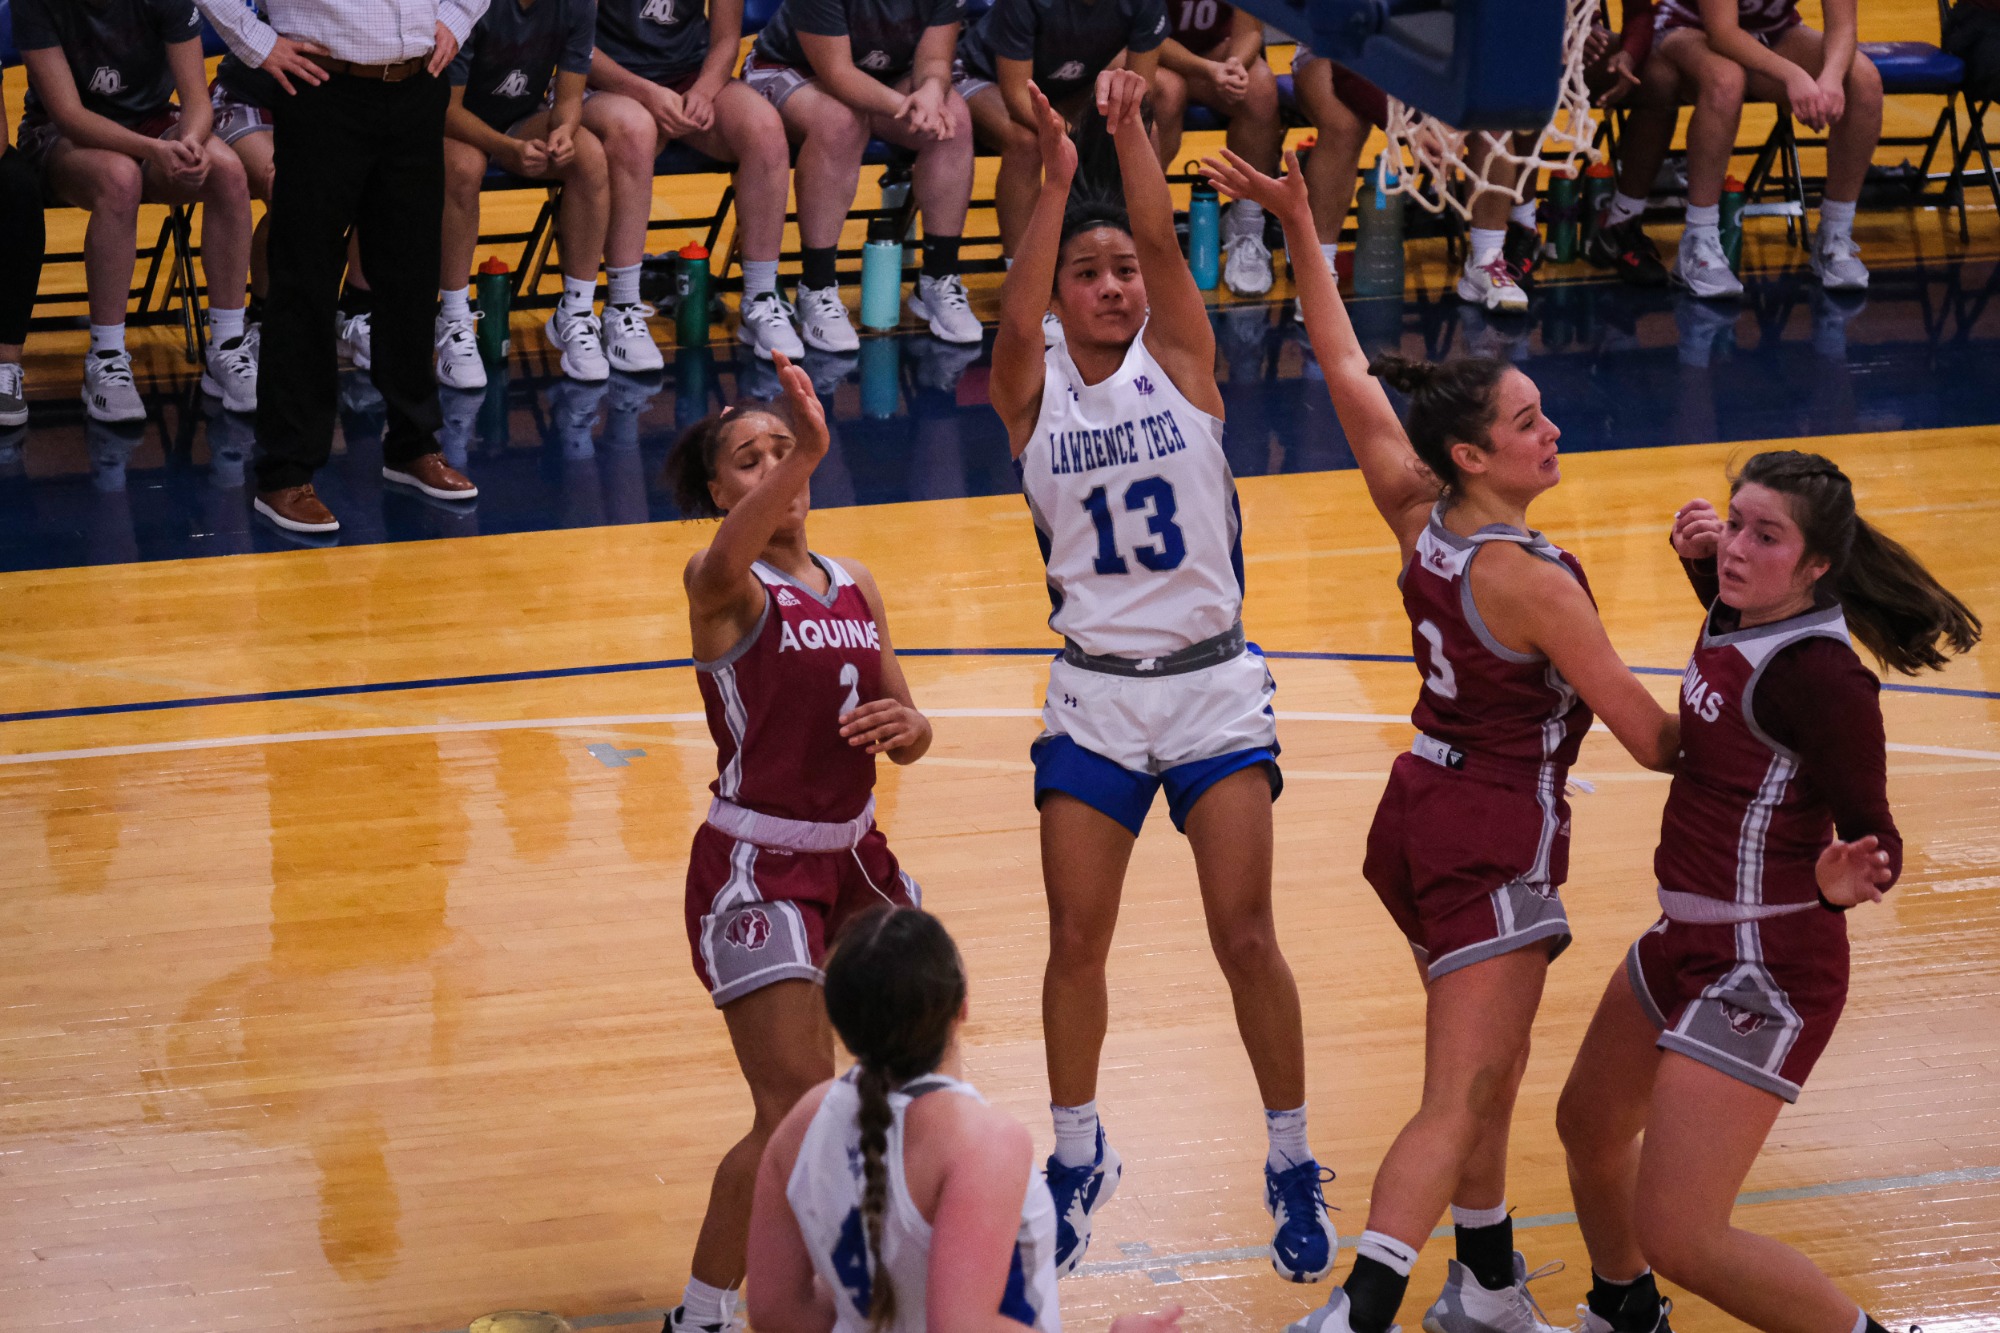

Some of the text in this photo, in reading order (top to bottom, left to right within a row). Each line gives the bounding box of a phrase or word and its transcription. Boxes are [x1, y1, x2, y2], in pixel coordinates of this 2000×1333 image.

[1179, 0, 1217, 31] 10
[1049, 409, 1188, 475] LAWRENCE TECH
[1081, 474, 1188, 575] 13
[839, 662, 860, 717] 2
[1417, 618, 1458, 700] 3
